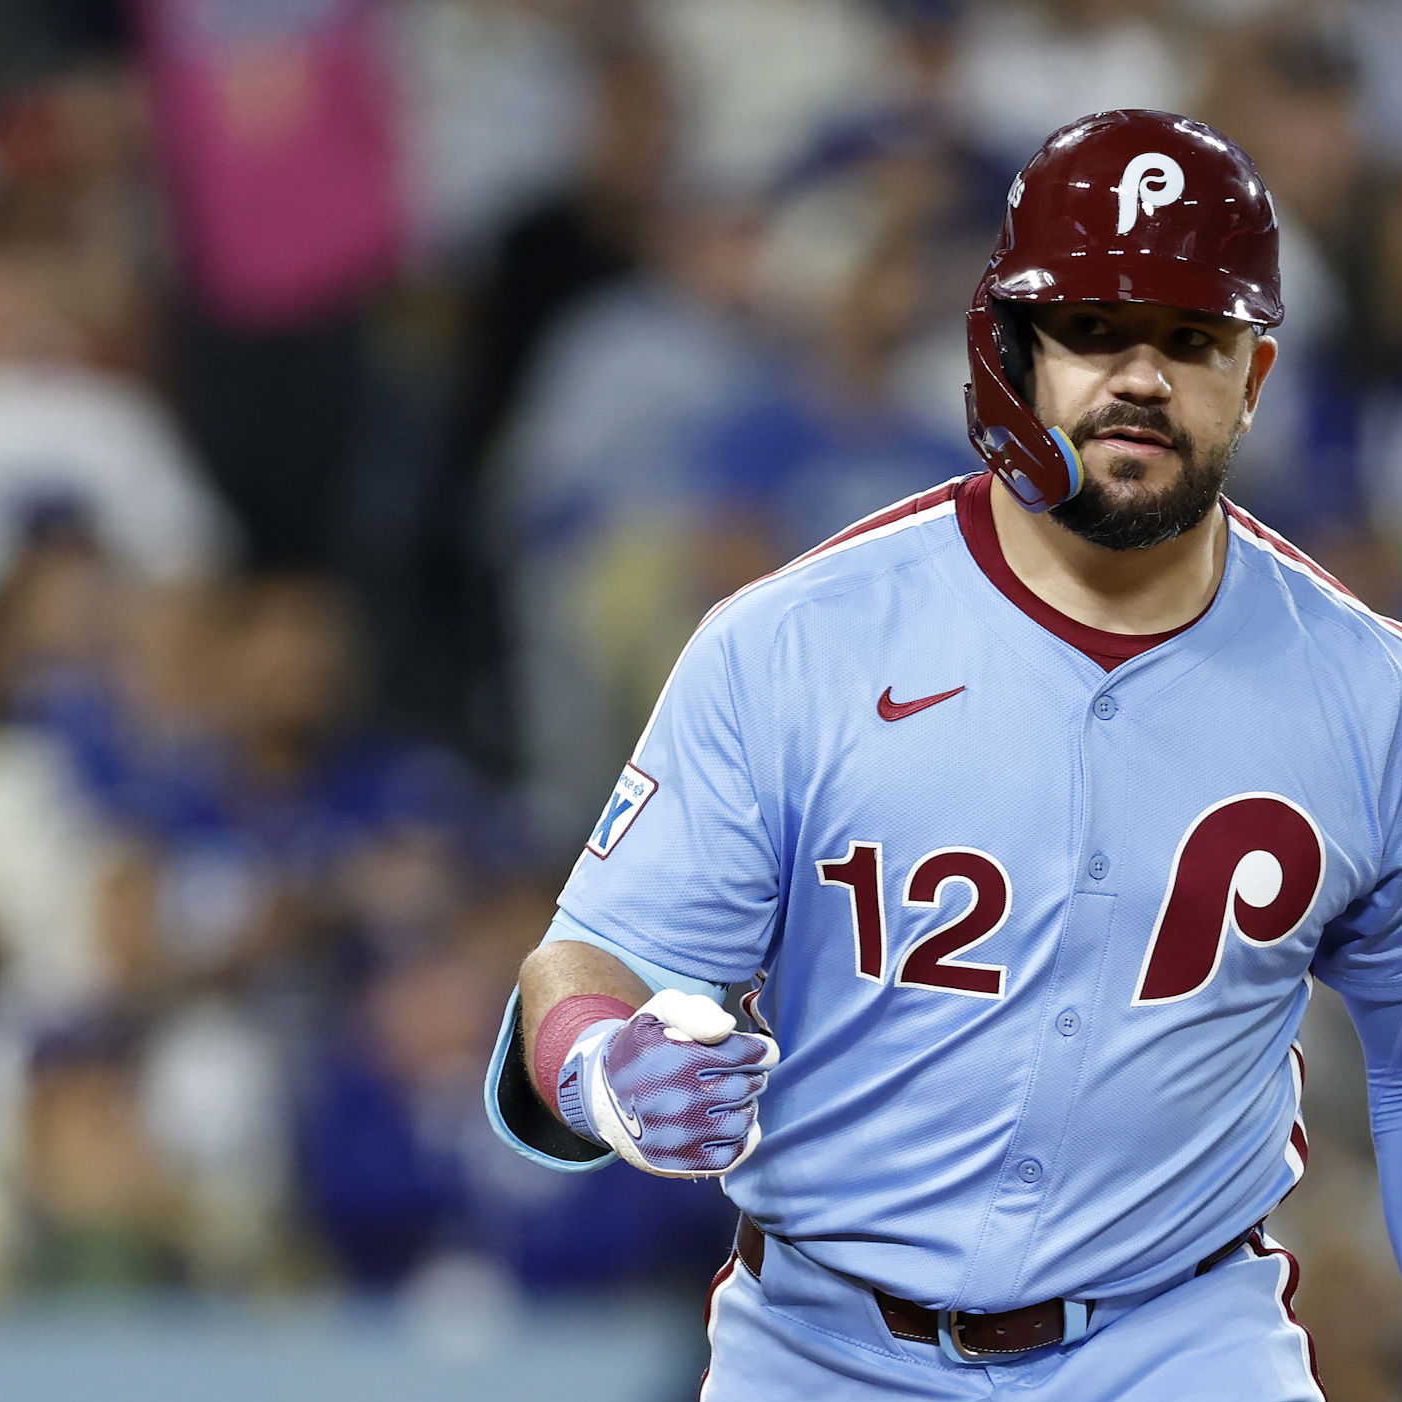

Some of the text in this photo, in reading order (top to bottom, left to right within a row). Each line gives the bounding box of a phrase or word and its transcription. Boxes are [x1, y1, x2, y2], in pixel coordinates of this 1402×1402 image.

[1116, 152, 1186, 235] P
[814, 839, 1013, 1000] 12
[1130, 790, 1327, 1007] P
